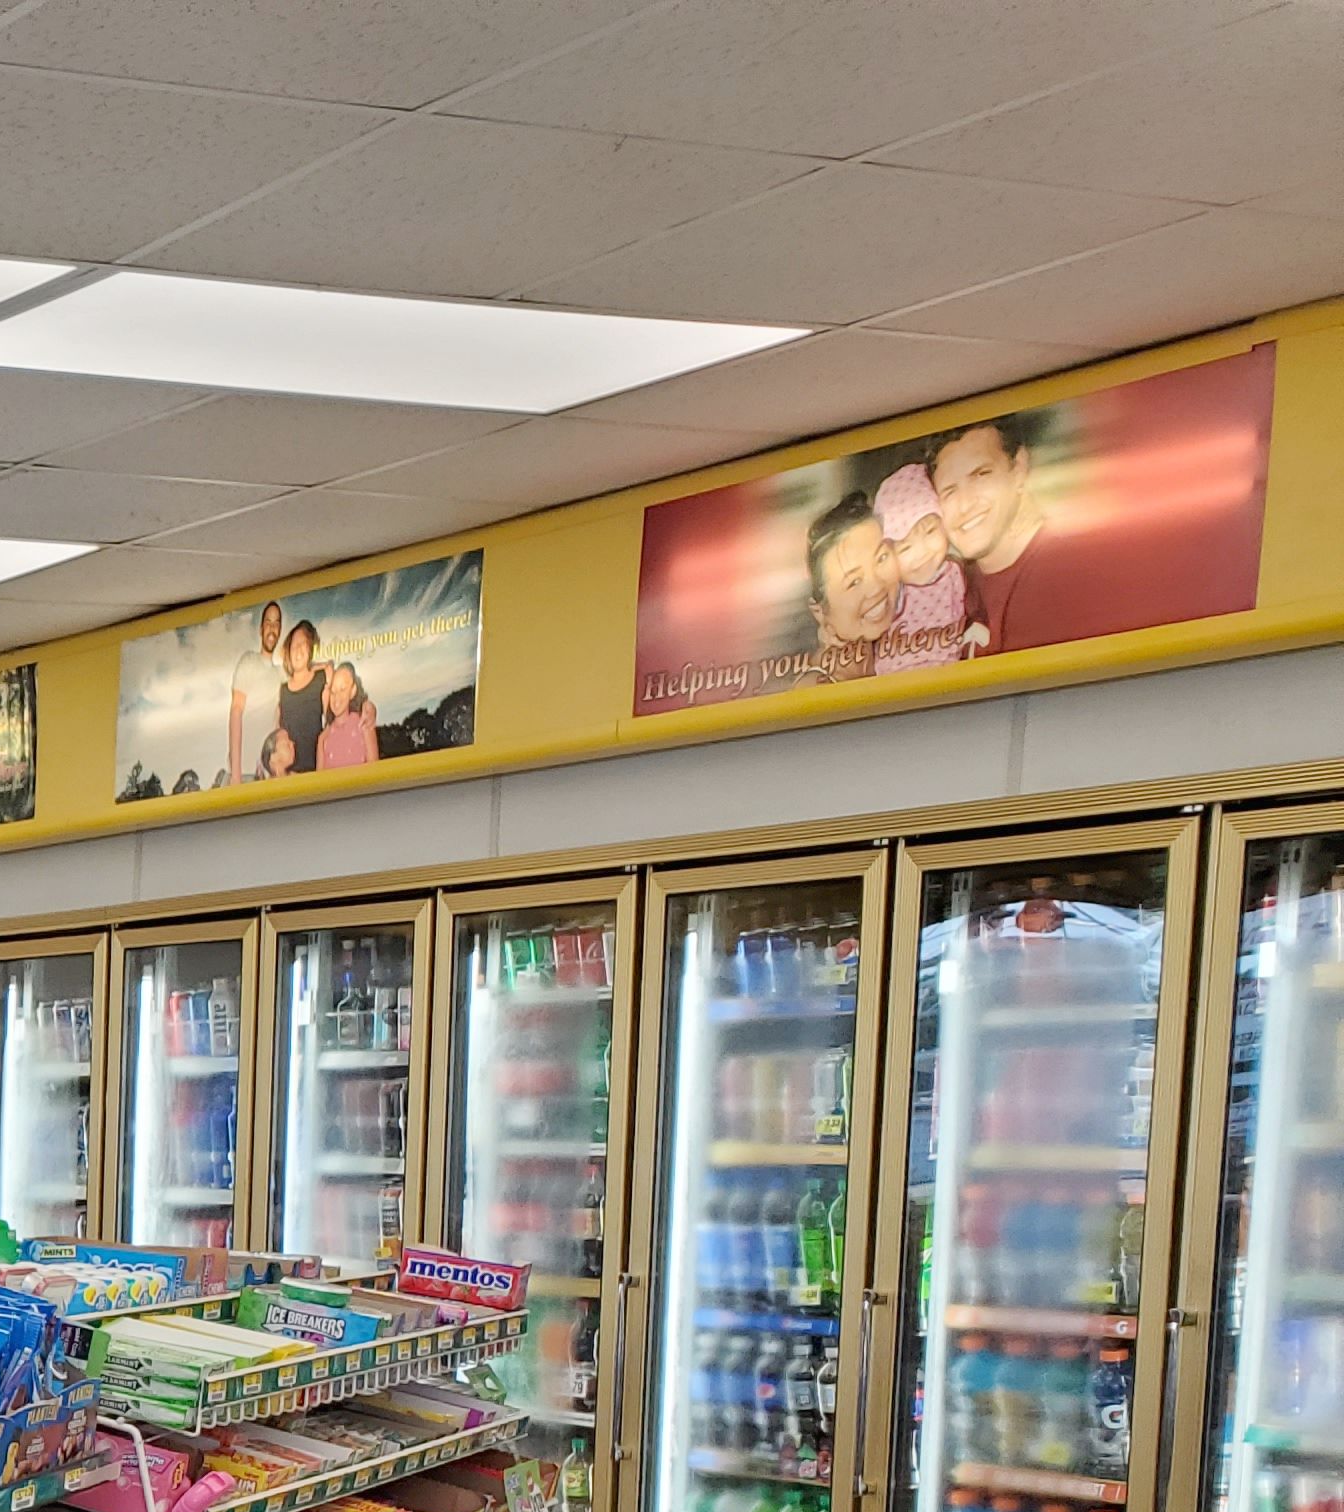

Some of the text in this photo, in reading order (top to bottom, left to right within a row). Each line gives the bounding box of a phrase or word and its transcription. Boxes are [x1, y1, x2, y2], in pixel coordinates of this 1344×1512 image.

[313, 609, 472, 661] Helping you get there!
[642, 621, 965, 704] Helping you get there!
[406, 1258, 513, 1290] mentos
[266, 1304, 346, 1339] ICE BREAKERS
